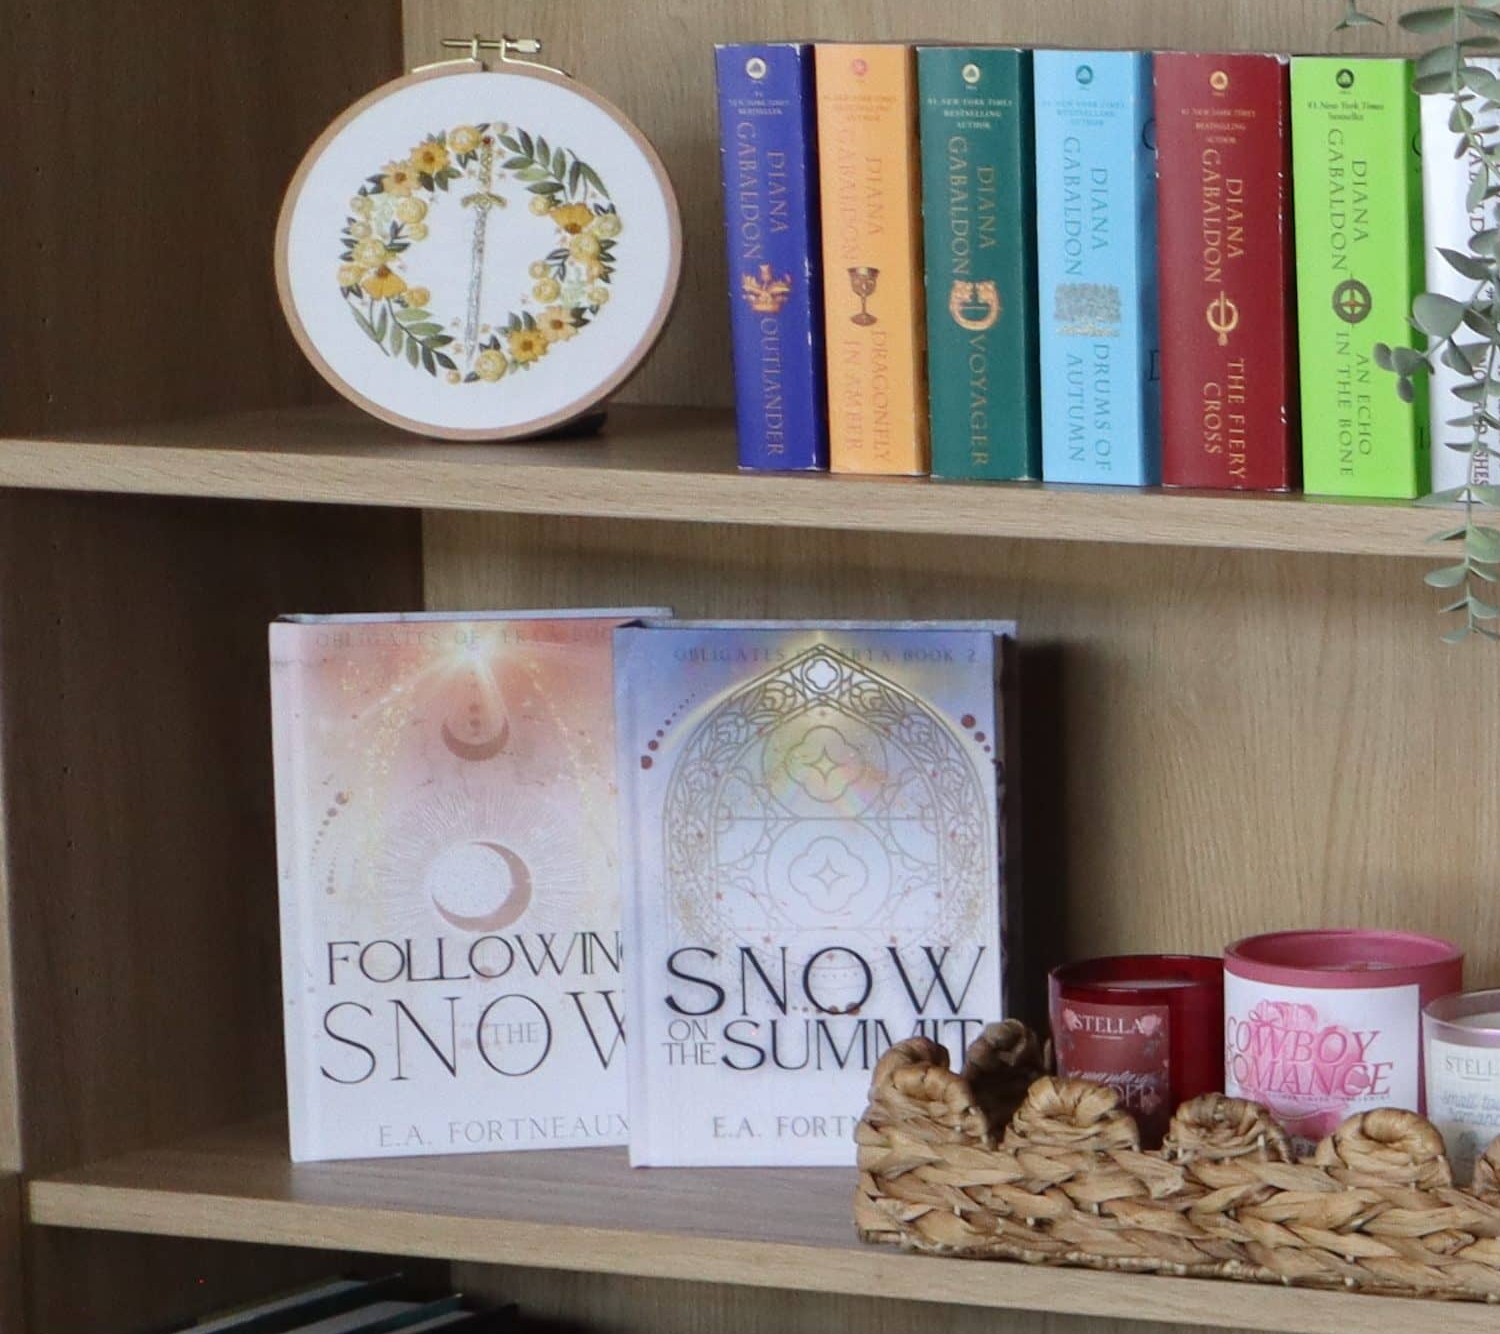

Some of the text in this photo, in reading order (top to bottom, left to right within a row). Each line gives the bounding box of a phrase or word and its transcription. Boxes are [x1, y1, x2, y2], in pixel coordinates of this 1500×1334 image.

[1328, 128, 1348, 272] GABALDON
[1352, 160, 1370, 243] DIANA
[758, 316, 785, 459] OUTLANDER
[964, 330, 991, 468] VOYAGER
[1200, 380, 1224, 457] CROSS
[1227, 355, 1249, 482] THE FIERY
[663, 944, 988, 1016] SNOW
[1073, 1013, 1144, 1036] STELLA
